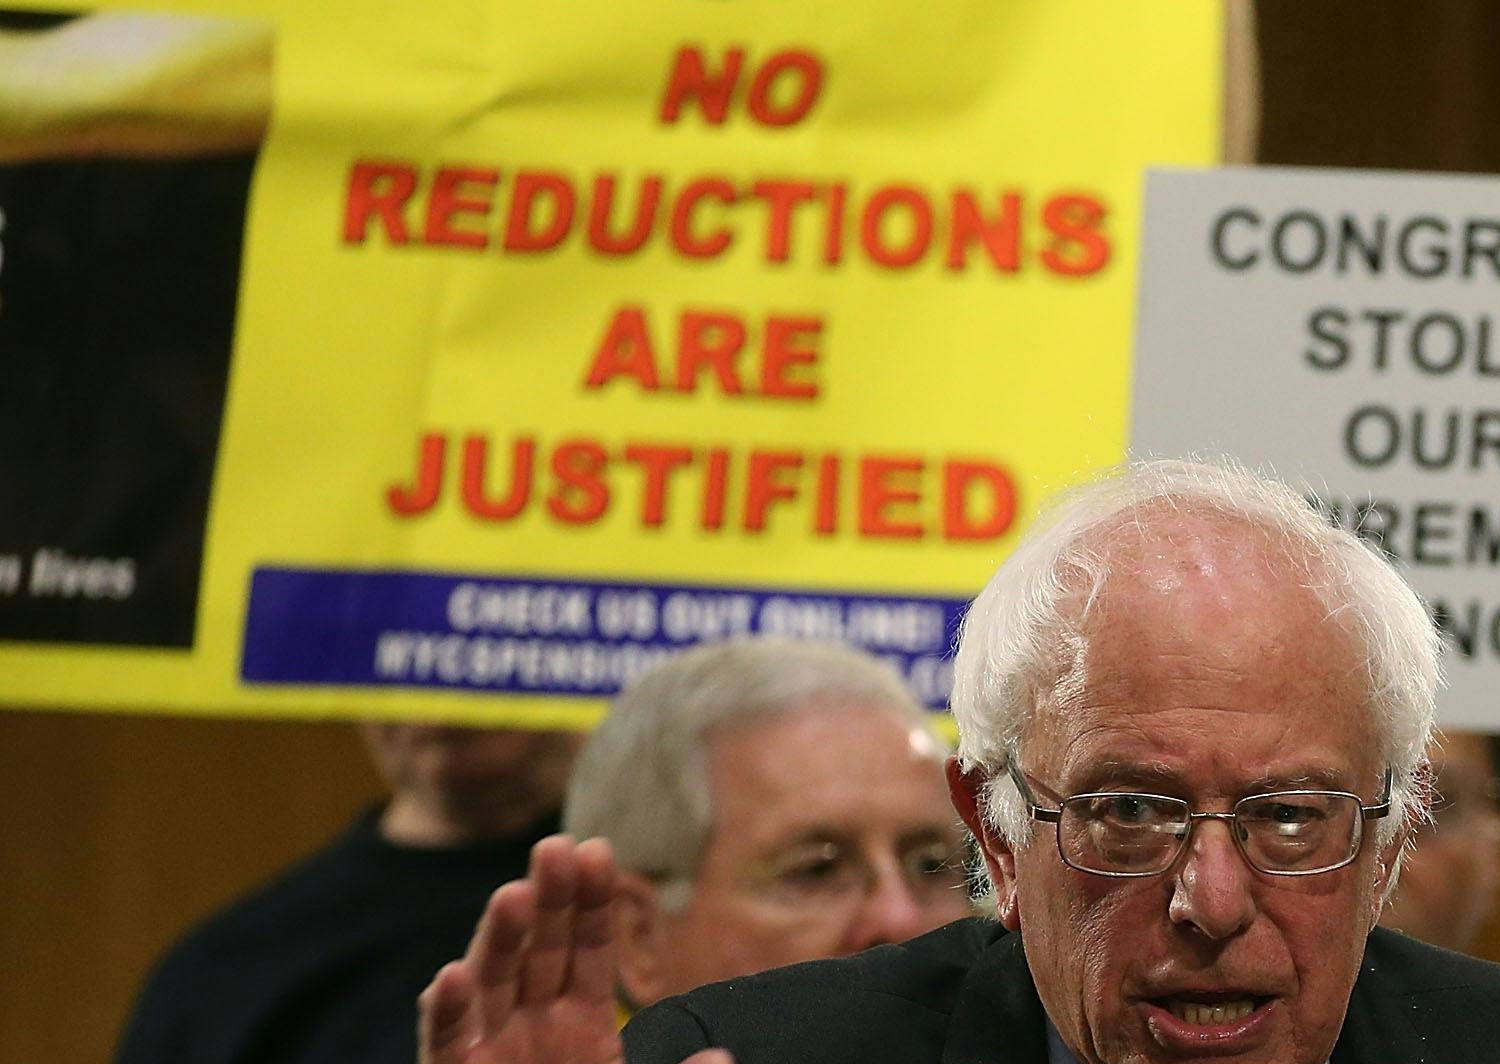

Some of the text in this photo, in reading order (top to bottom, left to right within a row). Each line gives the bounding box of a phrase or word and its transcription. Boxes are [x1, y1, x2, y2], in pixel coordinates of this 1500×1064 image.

[658, 44, 826, 130] NO
[340, 159, 1114, 280] REDUCTIONS
[582, 303, 826, 402] ARE
[384, 430, 1022, 545] JUSTIFIED
[446, 581, 591, 636] CHECK
[595, 589, 657, 641] US
